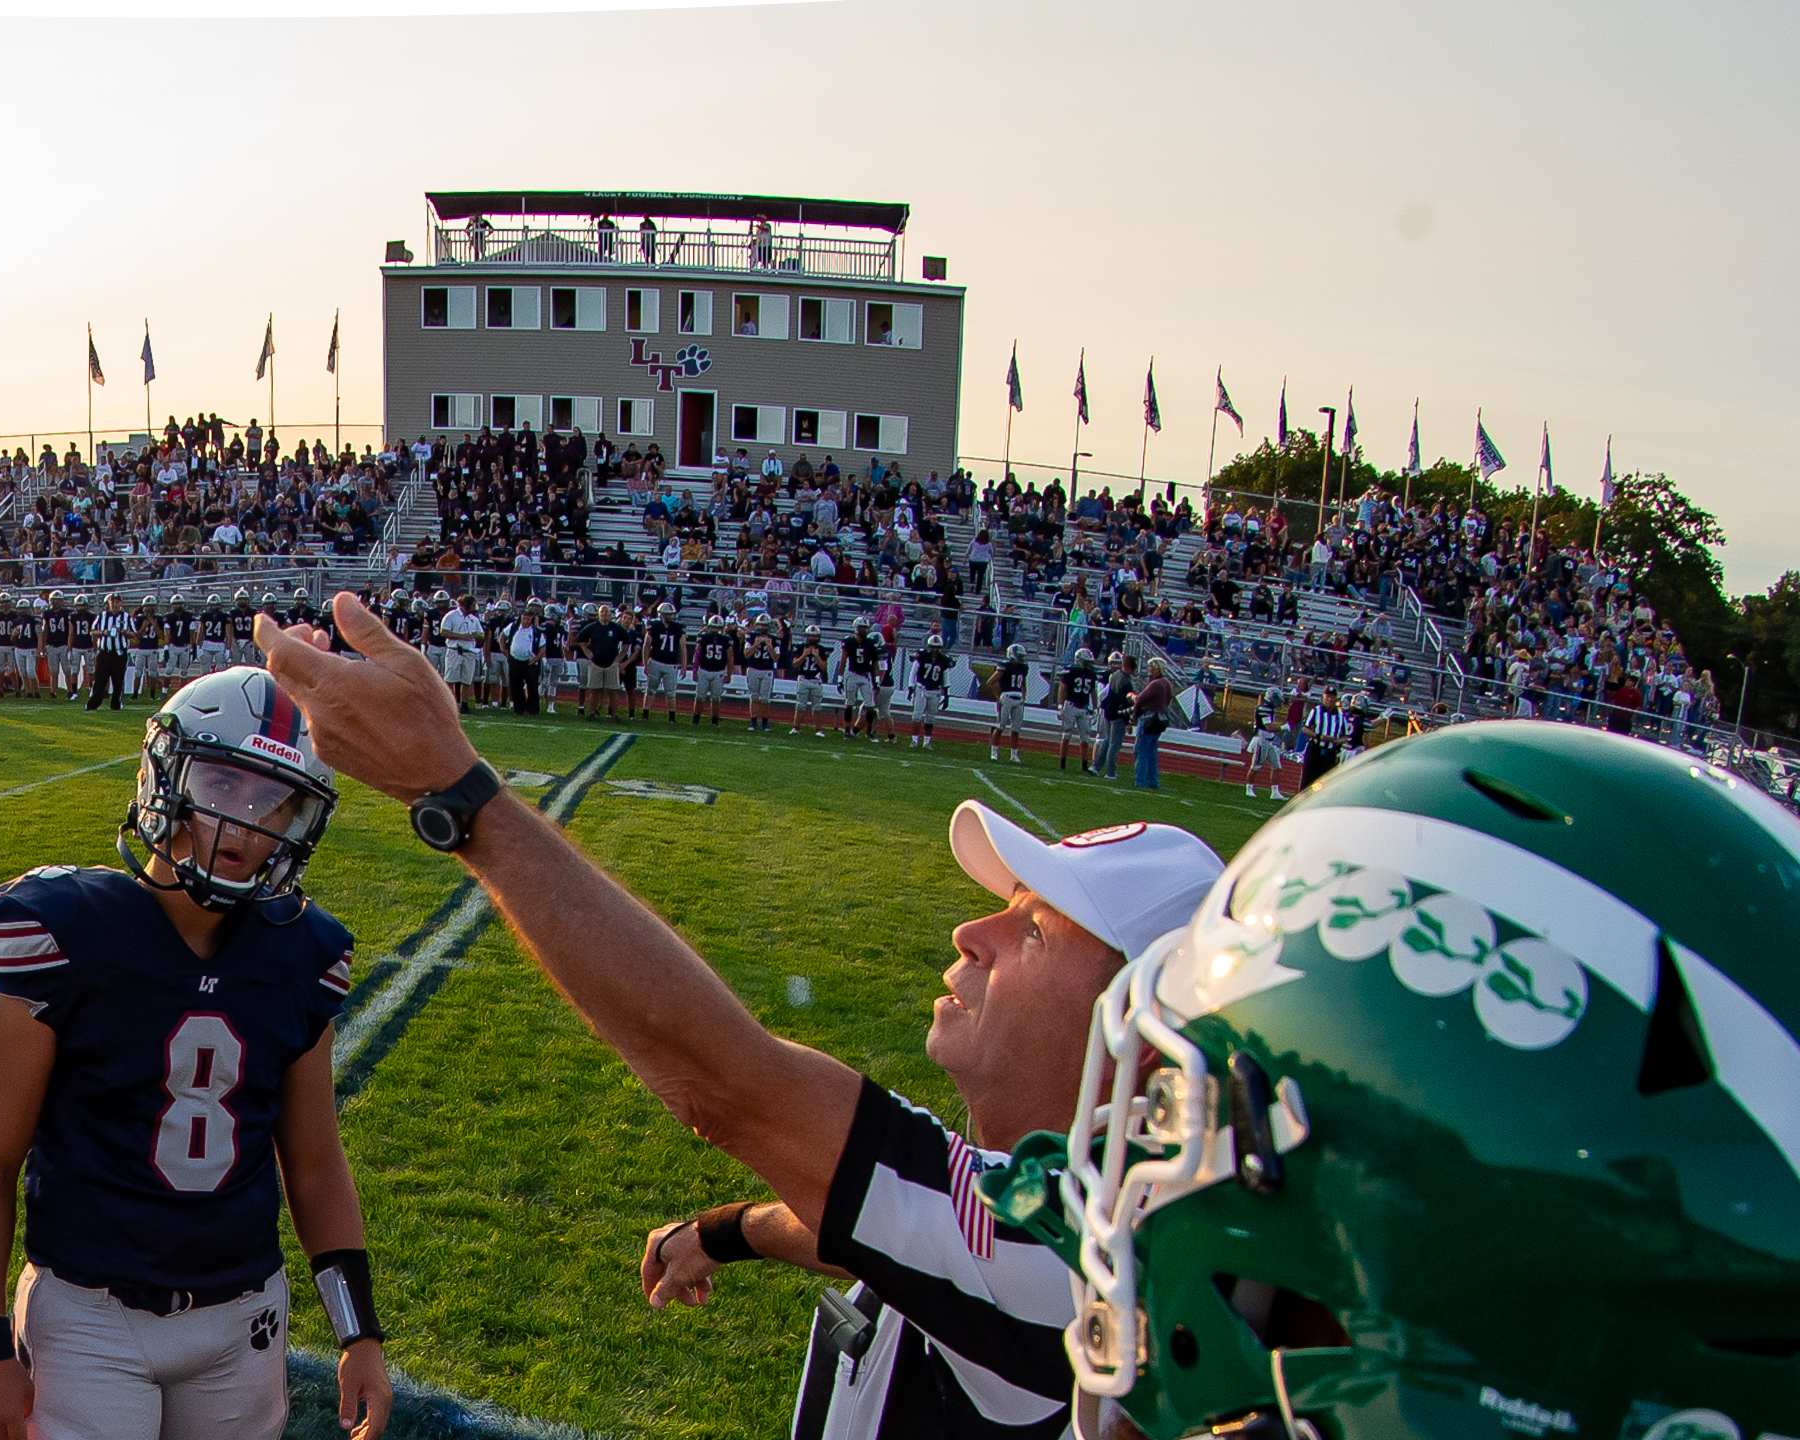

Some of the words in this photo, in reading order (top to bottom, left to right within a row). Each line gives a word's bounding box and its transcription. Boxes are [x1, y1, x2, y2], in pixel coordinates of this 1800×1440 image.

[49, 616, 66, 633] 64
[76, 619, 89, 635] 13
[176, 620, 184, 637] 7
[205, 620, 222, 637] 24
[659, 634, 675, 652] 71
[856, 648, 865, 664] 5
[1073, 677, 1092, 695] 35
[252, 736, 302, 764] Riddell
[198, 975, 219, 994] LT
[149, 1010, 247, 1192] 8
